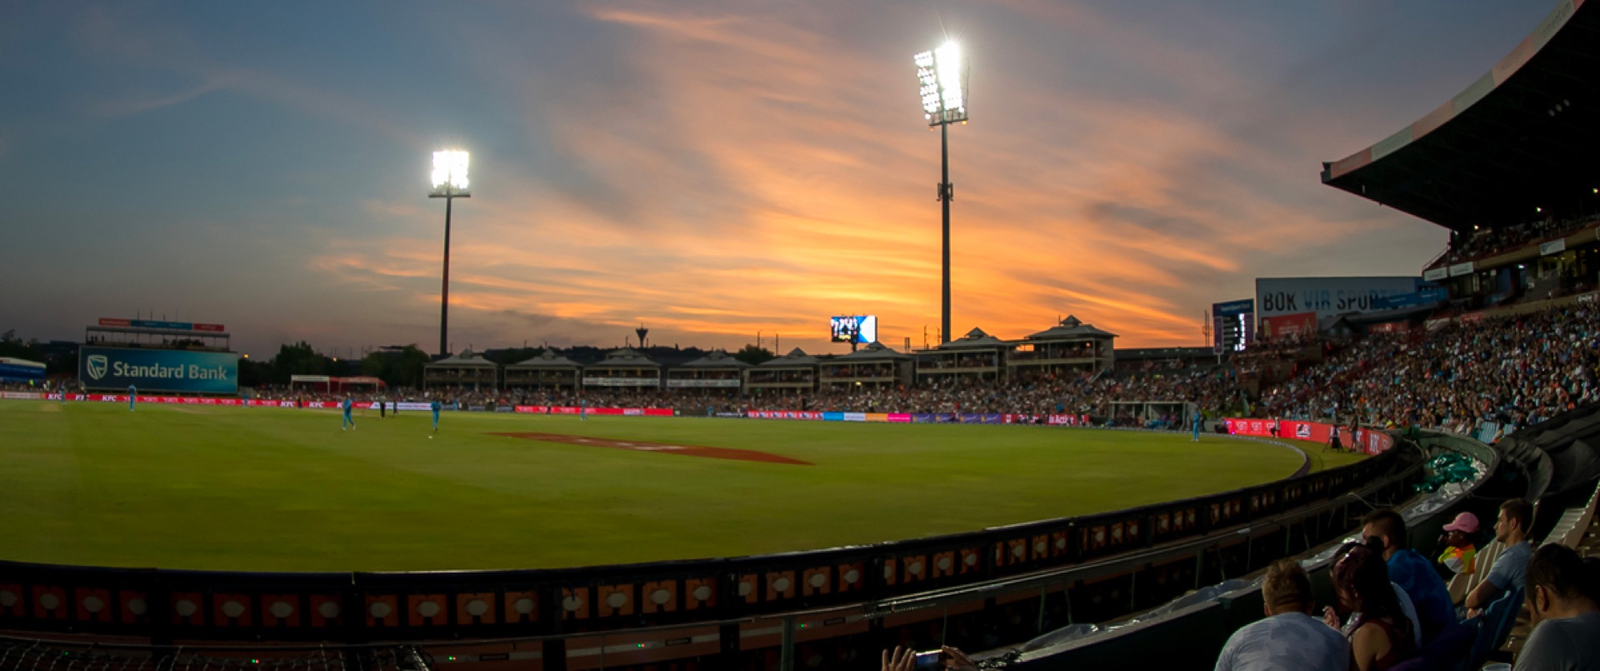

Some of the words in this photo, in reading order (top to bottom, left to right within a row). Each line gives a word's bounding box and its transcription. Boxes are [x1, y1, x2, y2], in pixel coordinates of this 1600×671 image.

[1263, 291, 1297, 311] BOK
[1304, 290, 1331, 310] VIR
[113, 360, 184, 379] Standard
[188, 364, 227, 380] Bank
[102, 394, 117, 402] KFC
